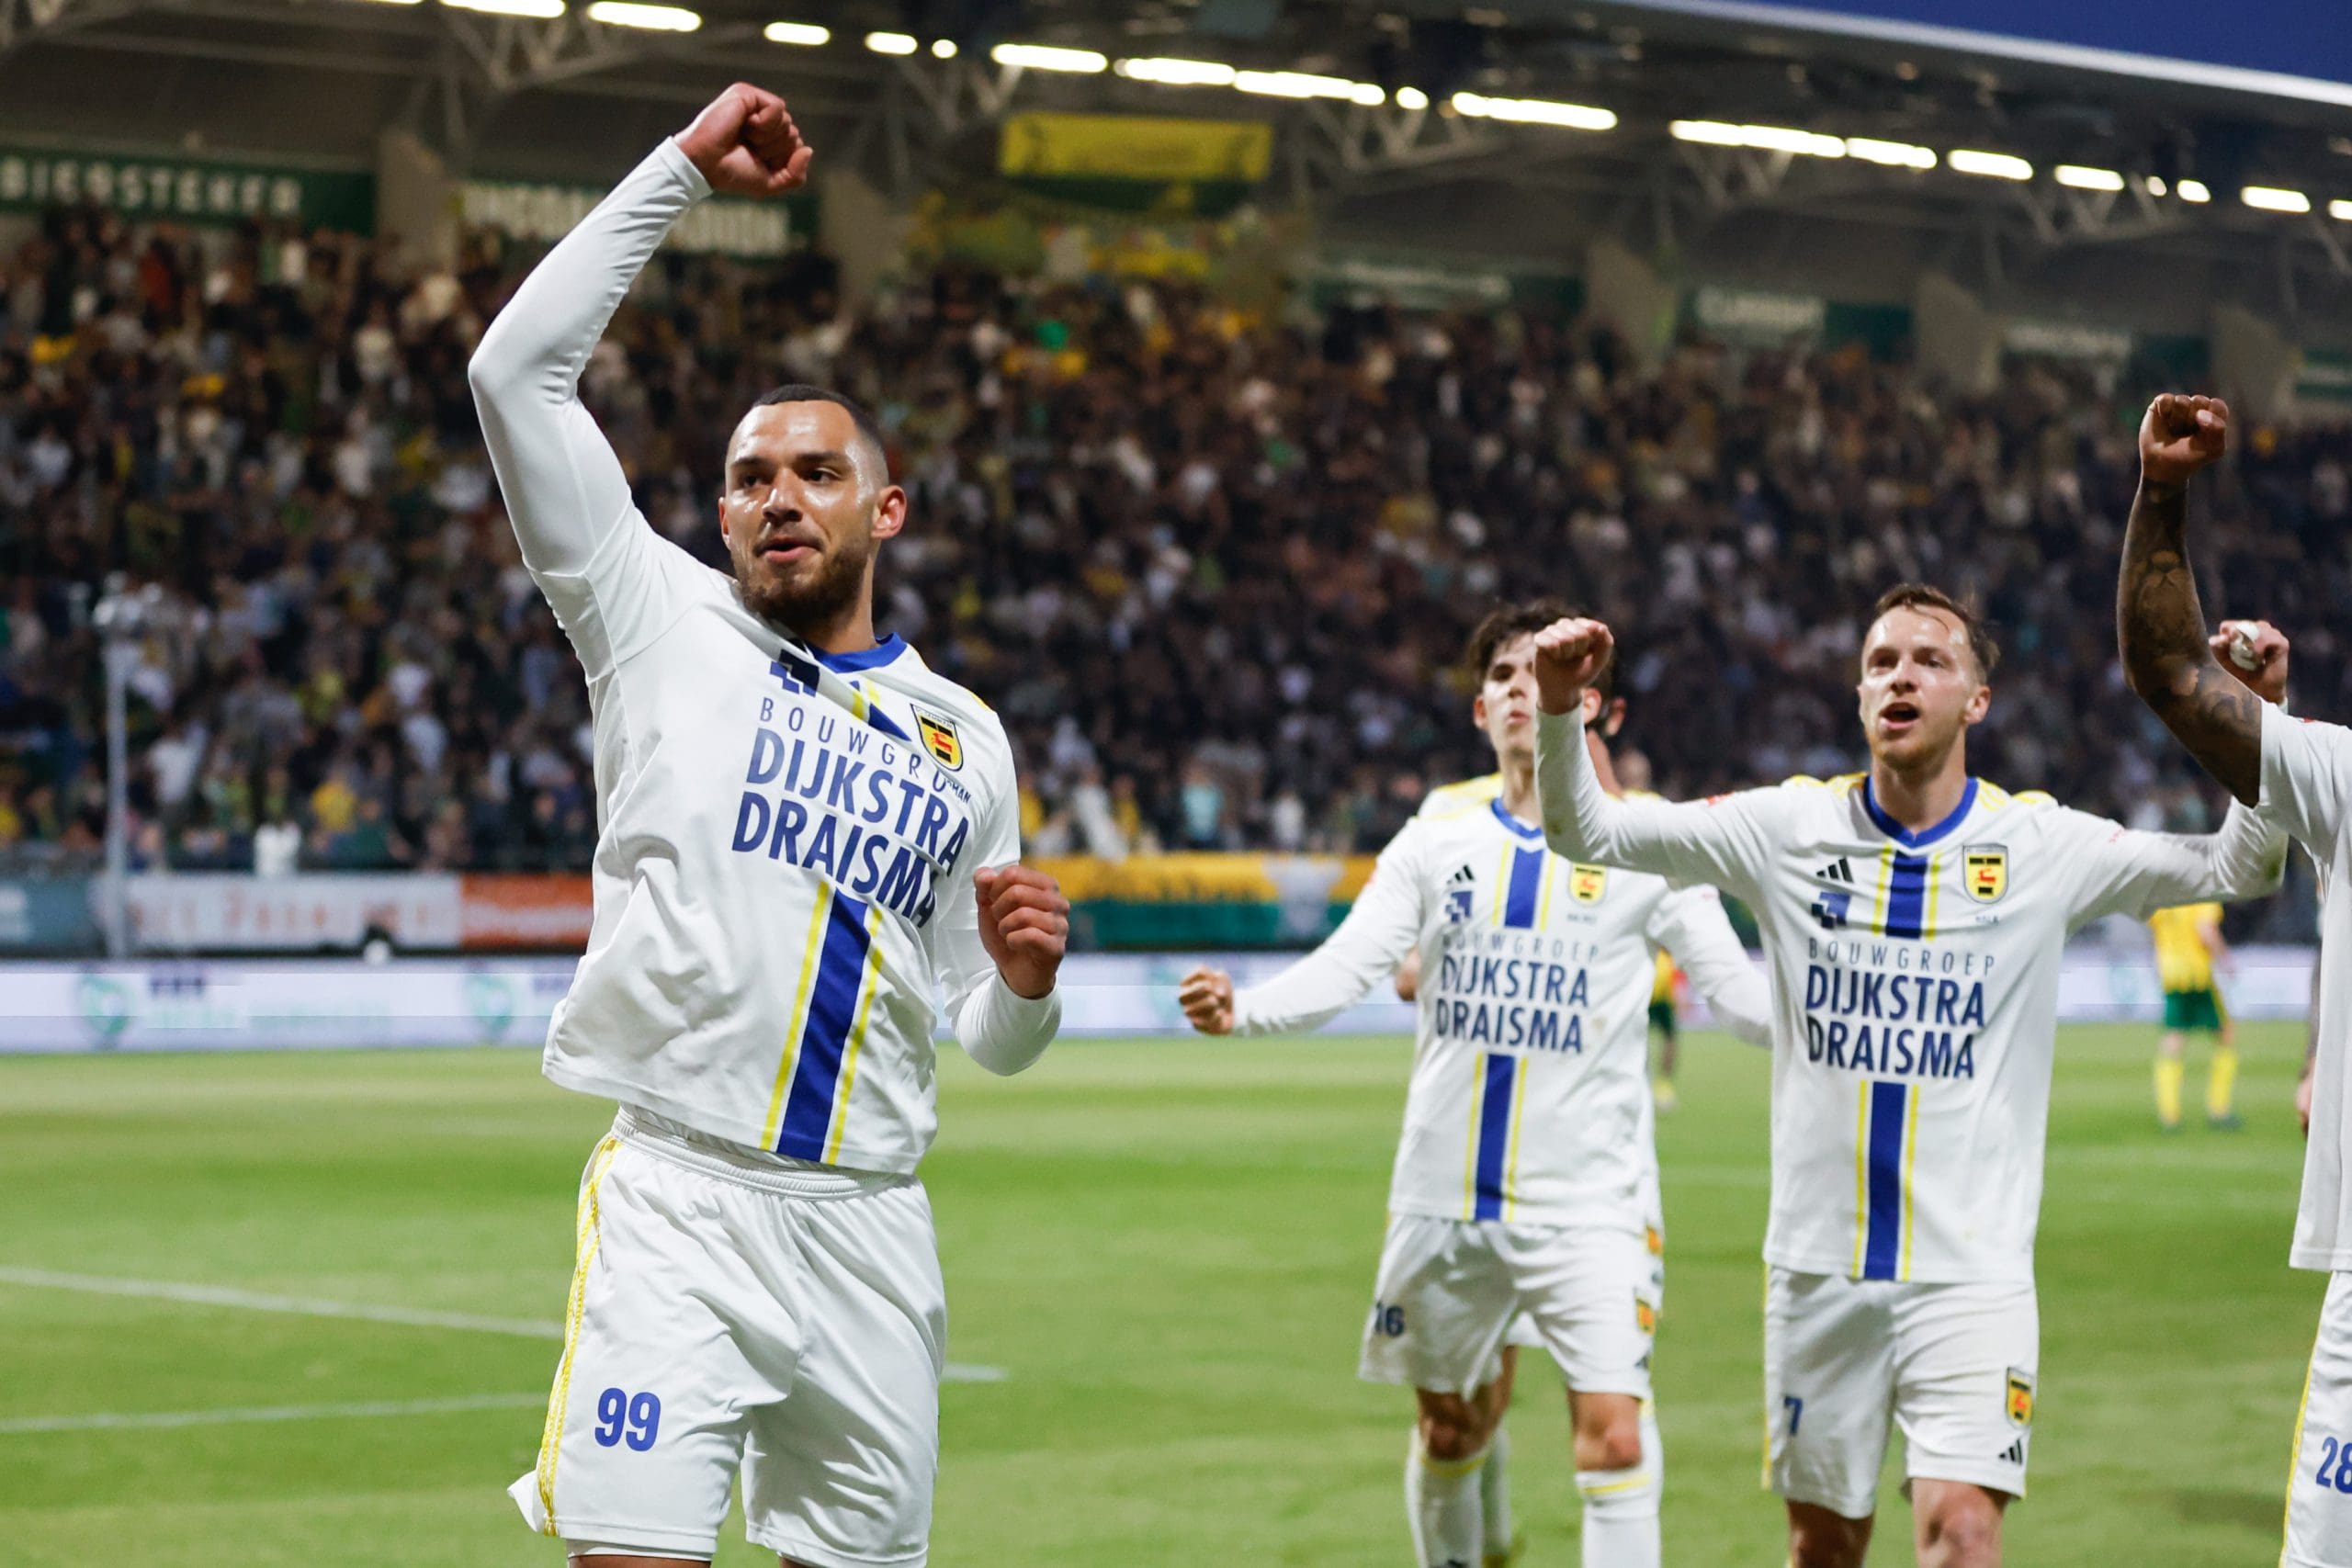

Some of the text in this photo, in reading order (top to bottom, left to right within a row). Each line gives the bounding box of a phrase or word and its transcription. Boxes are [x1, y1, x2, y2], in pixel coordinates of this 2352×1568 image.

[746, 728, 969, 877] DIJKSTRA
[732, 790, 937, 929] DRAISMA
[1441, 954, 1589, 1008] DIJKSTRA
[1808, 938, 1996, 976] BOUWGROEP
[1436, 998, 1583, 1055] DRAISMA
[1806, 965, 1984, 1028] DIJKSTRA
[1806, 1016, 1975, 1078] DRAISMA
[594, 1387, 662, 1452] 99
[1783, 1395, 1804, 1437] 7
[2315, 1436, 2352, 1495] 28
